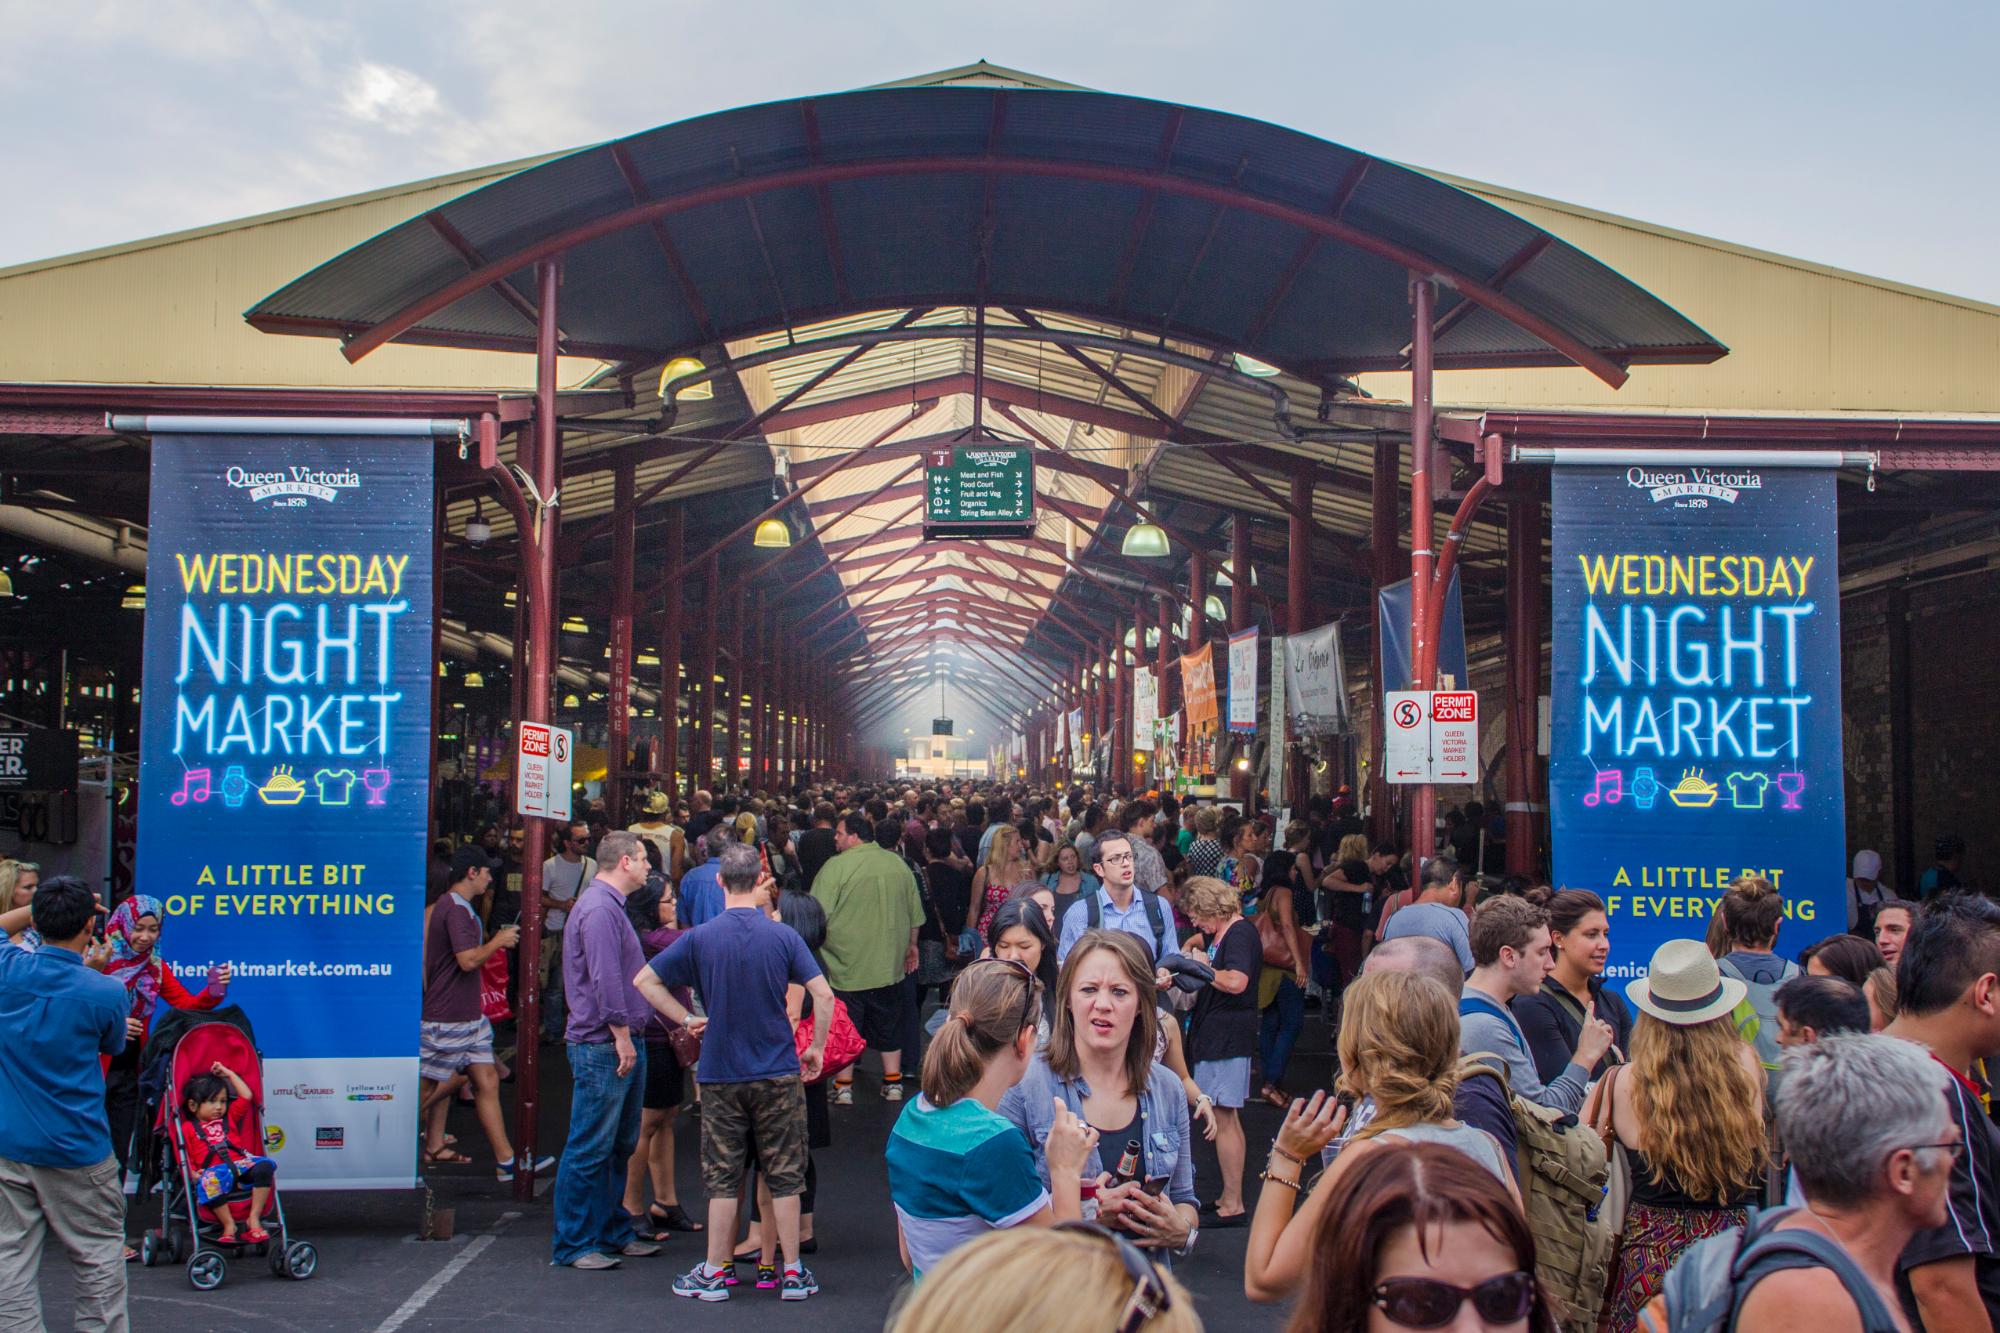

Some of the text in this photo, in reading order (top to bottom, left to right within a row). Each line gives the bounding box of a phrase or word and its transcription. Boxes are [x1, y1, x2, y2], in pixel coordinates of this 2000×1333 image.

[937, 455, 944, 466] J
[226, 466, 360, 488] Queen Victoria
[1626, 466, 1761, 488] Queen Victoria
[261, 483, 324, 495] MARKET
[1662, 485, 1725, 497] MARKET
[287, 497, 308, 507] 1878
[960, 500, 987, 508] Organics
[1688, 499, 1708, 508] 1878
[960, 509, 979, 517] String
[997, 509, 1013, 517] Alley
[175, 553, 409, 595] WEDNESDAY
[1578, 554, 1814, 597] WEDNESDAY
[175, 600, 408, 686] NIGHT
[1581, 603, 1815, 687] NIGHT
[1435, 696, 1473, 707] PERMIT
[1436, 708, 1472, 719] ZONE
[172, 692, 401, 755] MARKET
[1581, 695, 1812, 759] MARKET
[523, 728, 549, 742] PERMIT
[523, 741, 547, 754] ZONE
[527, 763, 543, 771] QUEEN
[525, 781, 543, 789] MARKET
[525, 790, 543, 799] HOLDER
[196, 864, 366, 886] A LITTLE BIT
[1612, 866, 1631, 887] A
[1642, 866, 1730, 889] LITTLE
[165, 893, 395, 916] OF EVERYTHING
[1632, 896, 1816, 921] EVERYNG
[165, 959, 392, 977] henhtmarket.com.au
